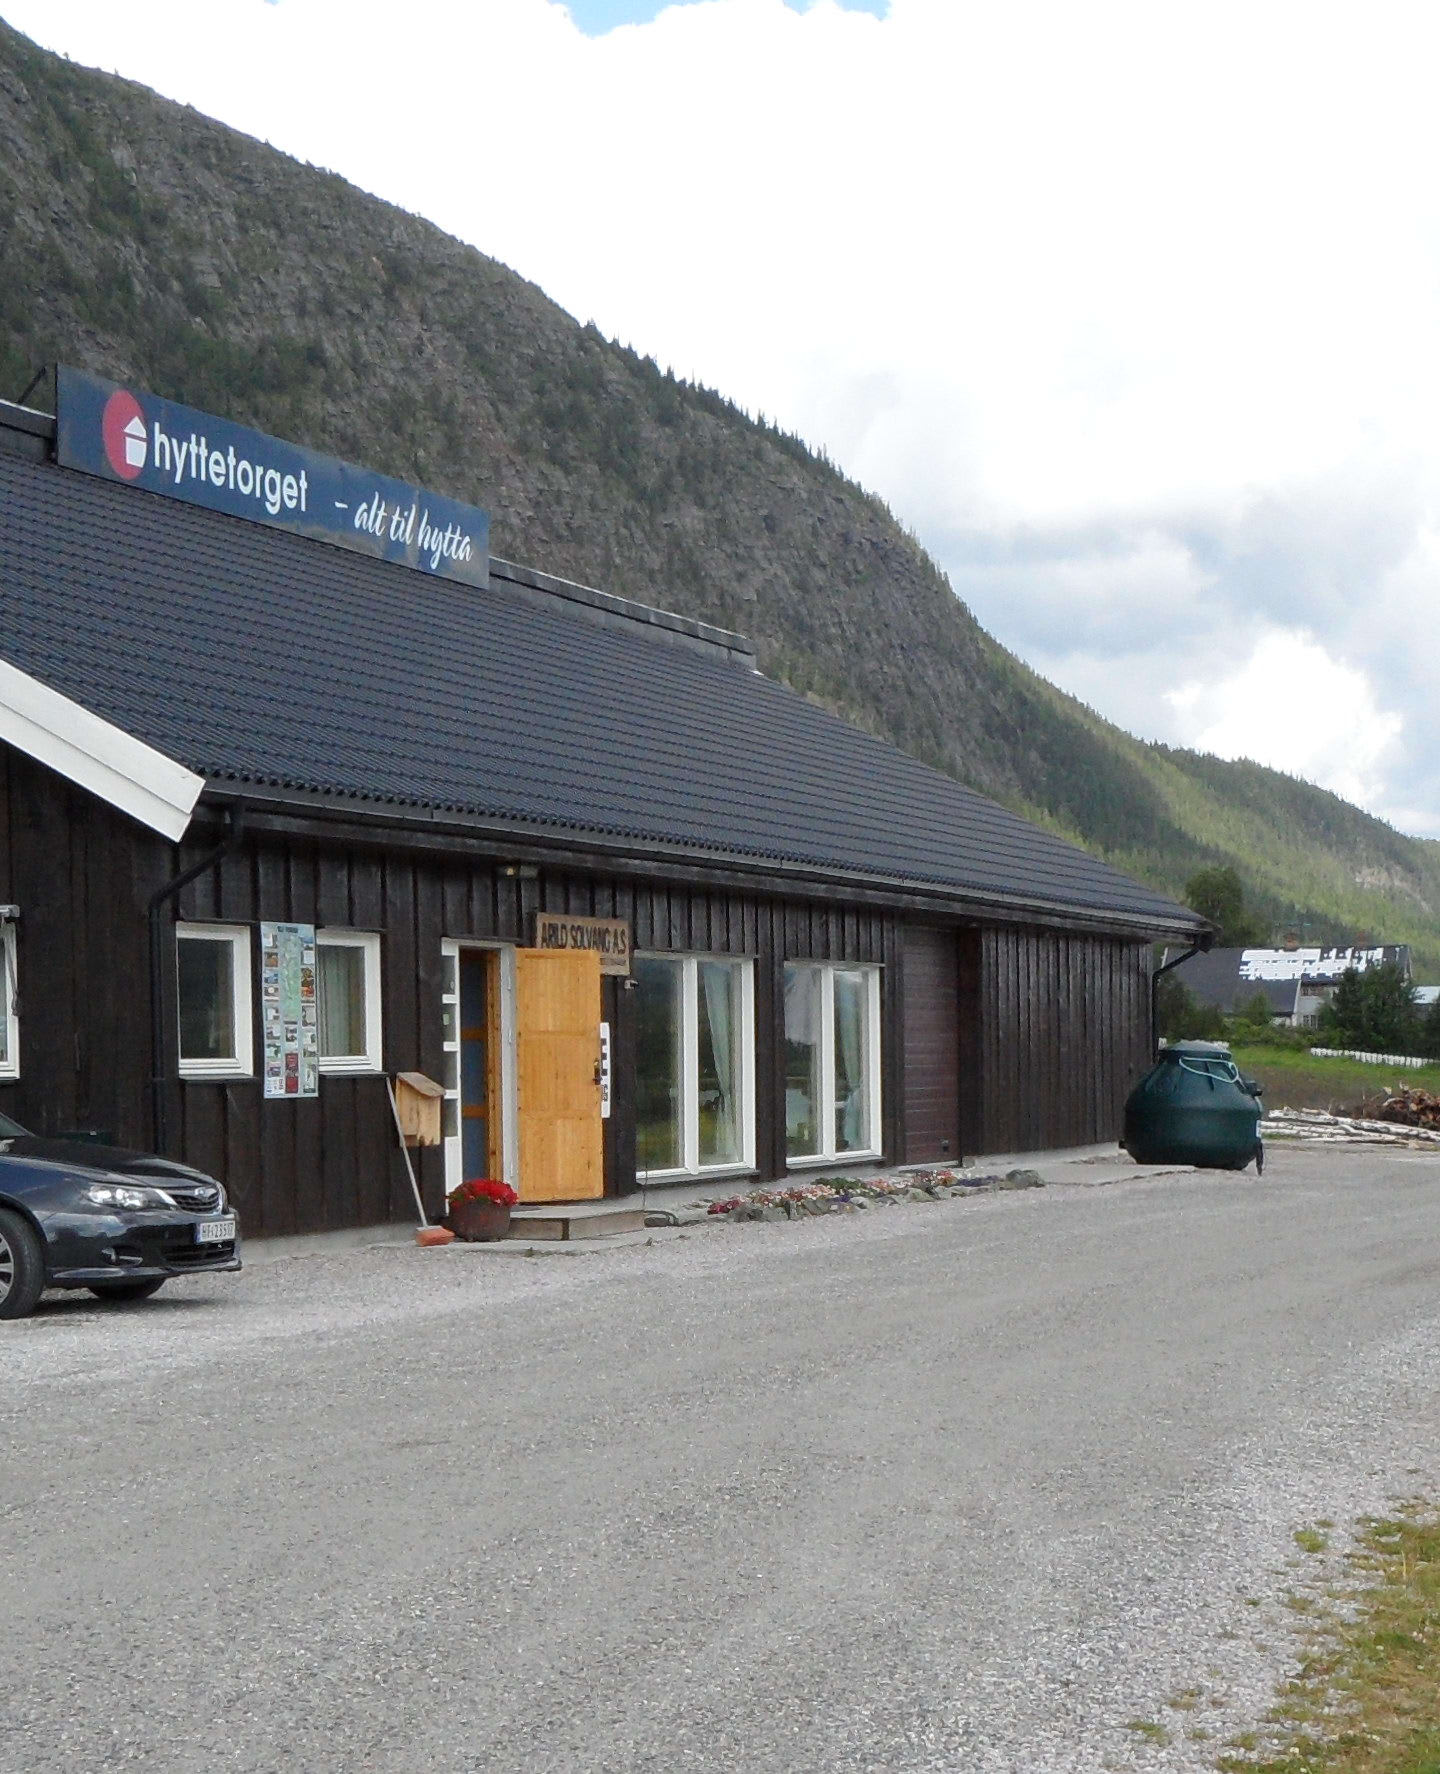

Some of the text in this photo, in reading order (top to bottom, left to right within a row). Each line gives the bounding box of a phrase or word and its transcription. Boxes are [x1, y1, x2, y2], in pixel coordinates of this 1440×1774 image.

[154, 421, 307, 515] hyttetorget
[354, 491, 388, 536] alt
[389, 504, 416, 545] til
[418, 508, 473, 570] hytta
